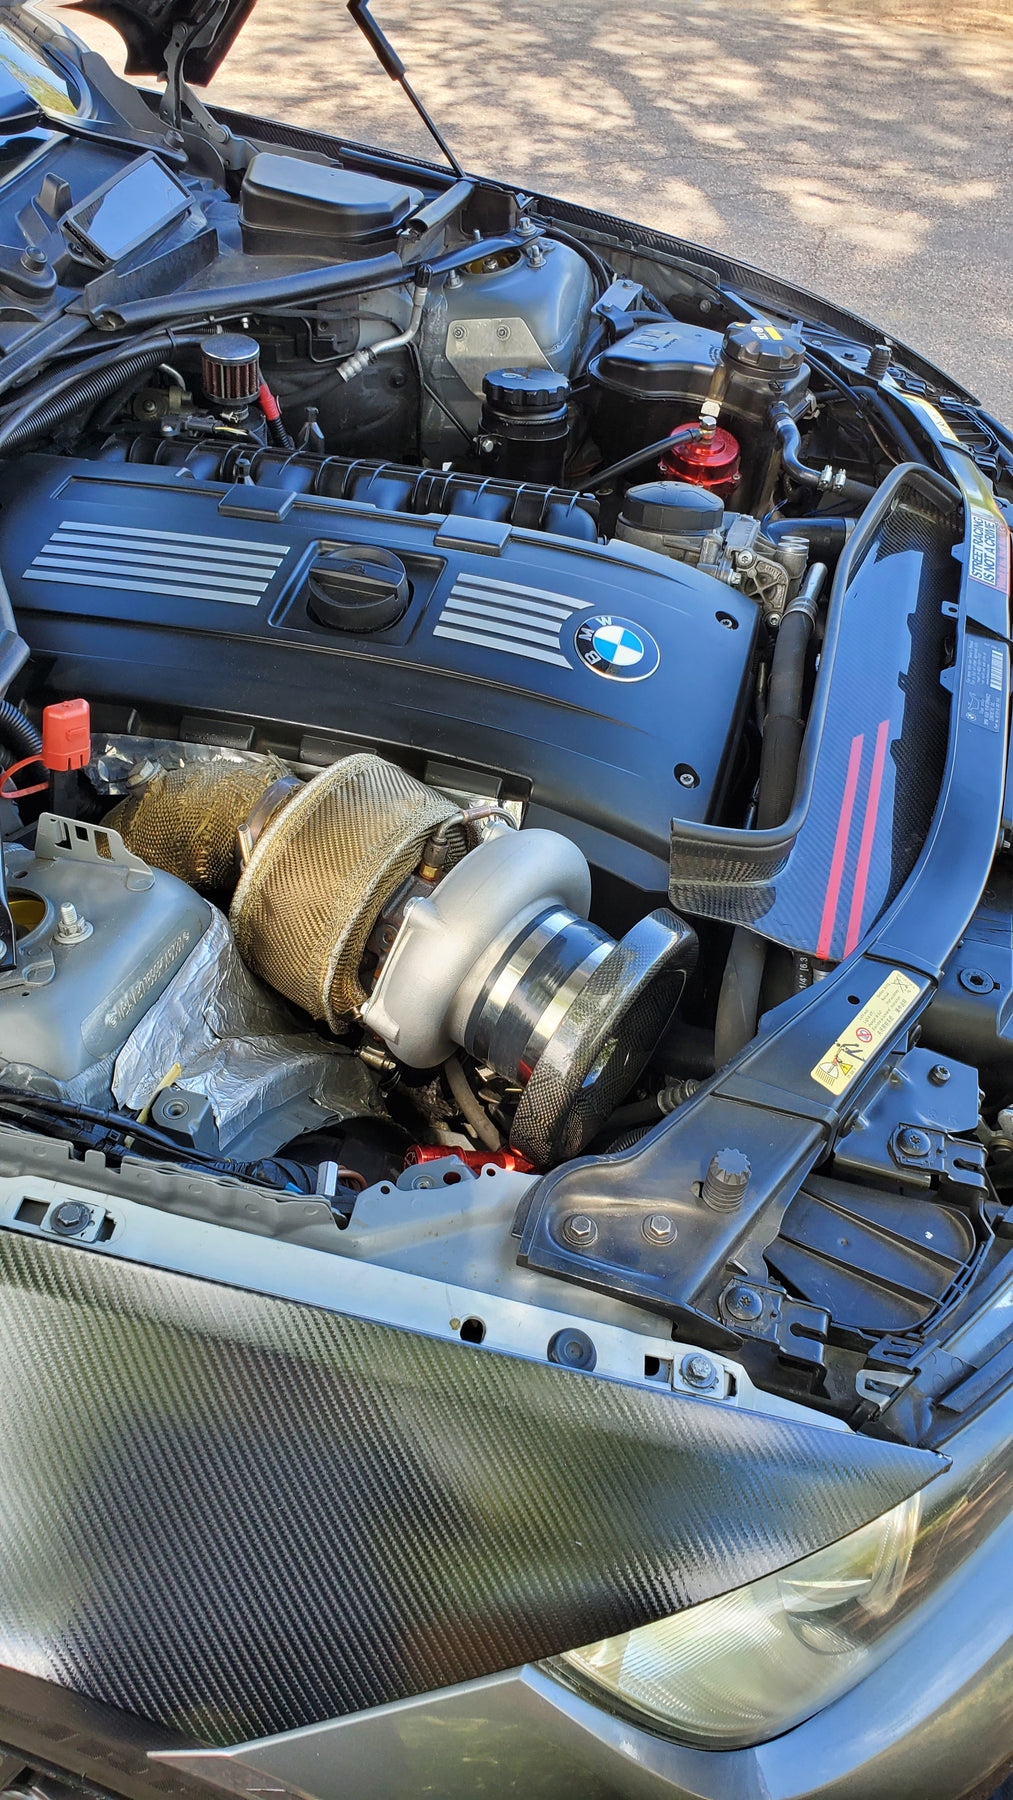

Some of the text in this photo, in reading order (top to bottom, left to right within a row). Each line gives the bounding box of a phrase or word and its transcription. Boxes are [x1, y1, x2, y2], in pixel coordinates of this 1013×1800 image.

[972, 517, 984, 579] STREET RACING
[983, 521, 995, 584] IS NOT A CRIME
[578, 616, 613, 665] BMW
